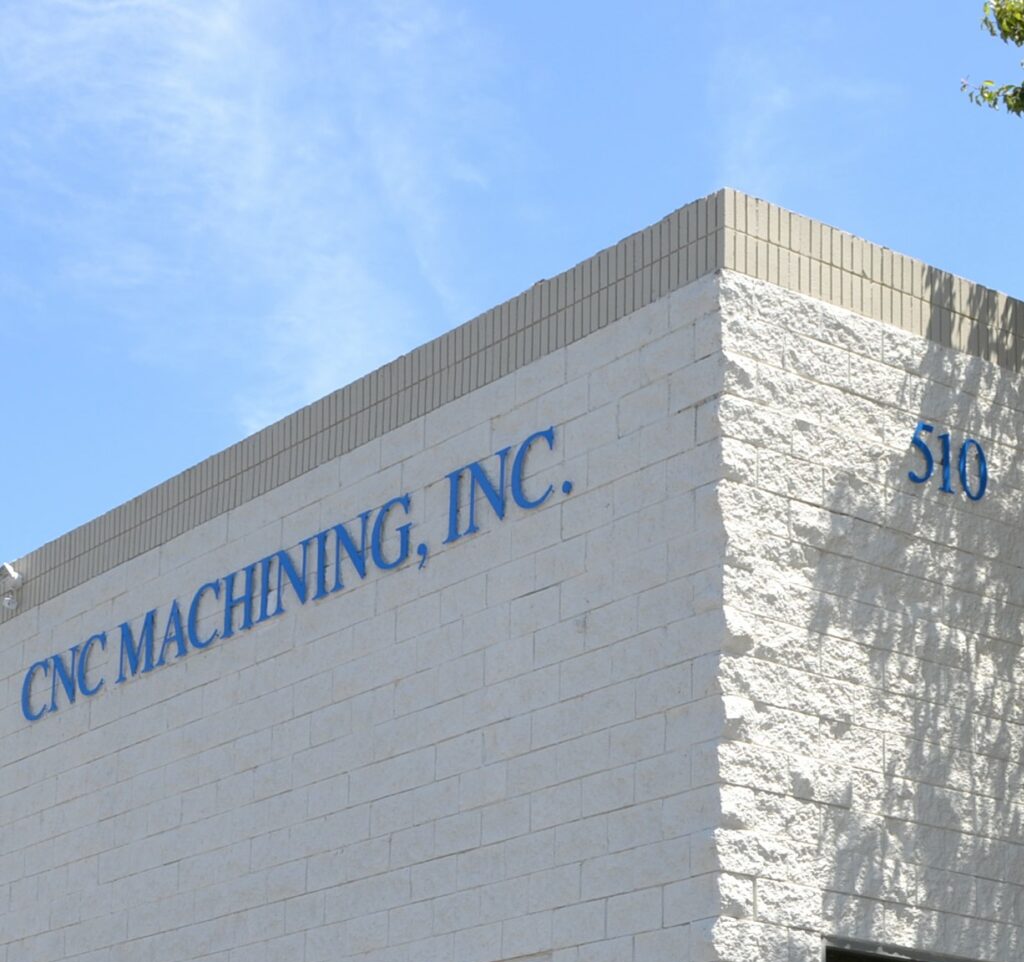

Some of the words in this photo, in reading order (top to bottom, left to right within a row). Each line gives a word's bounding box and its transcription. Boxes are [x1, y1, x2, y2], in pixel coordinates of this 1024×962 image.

[908, 421, 988, 500] 510
[21, 631, 107, 721] CNC
[115, 492, 428, 684] MACHINING,
[442, 426, 573, 544] INC.
